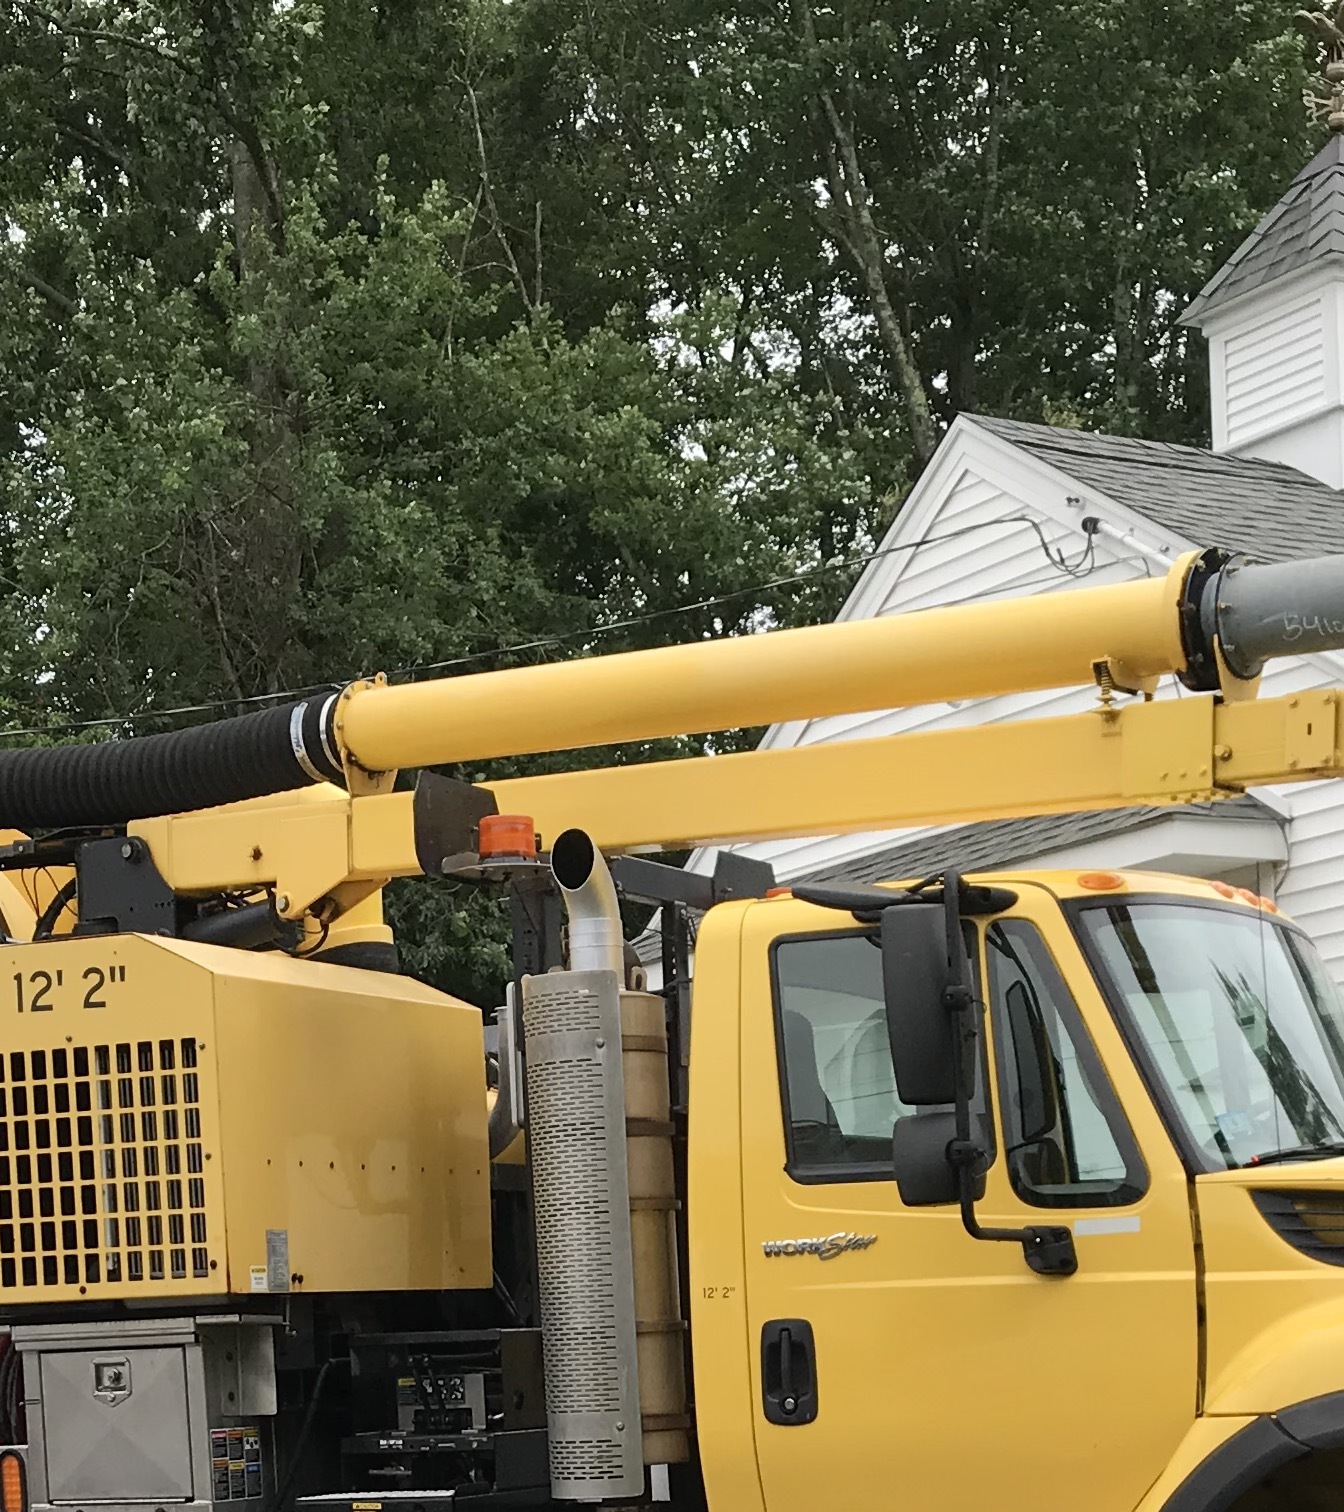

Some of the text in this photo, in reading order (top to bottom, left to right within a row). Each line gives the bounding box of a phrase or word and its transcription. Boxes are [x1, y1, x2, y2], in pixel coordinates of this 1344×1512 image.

[13, 965, 126, 1013] 12' 2"
[702, 1287, 718, 1299] 12'
